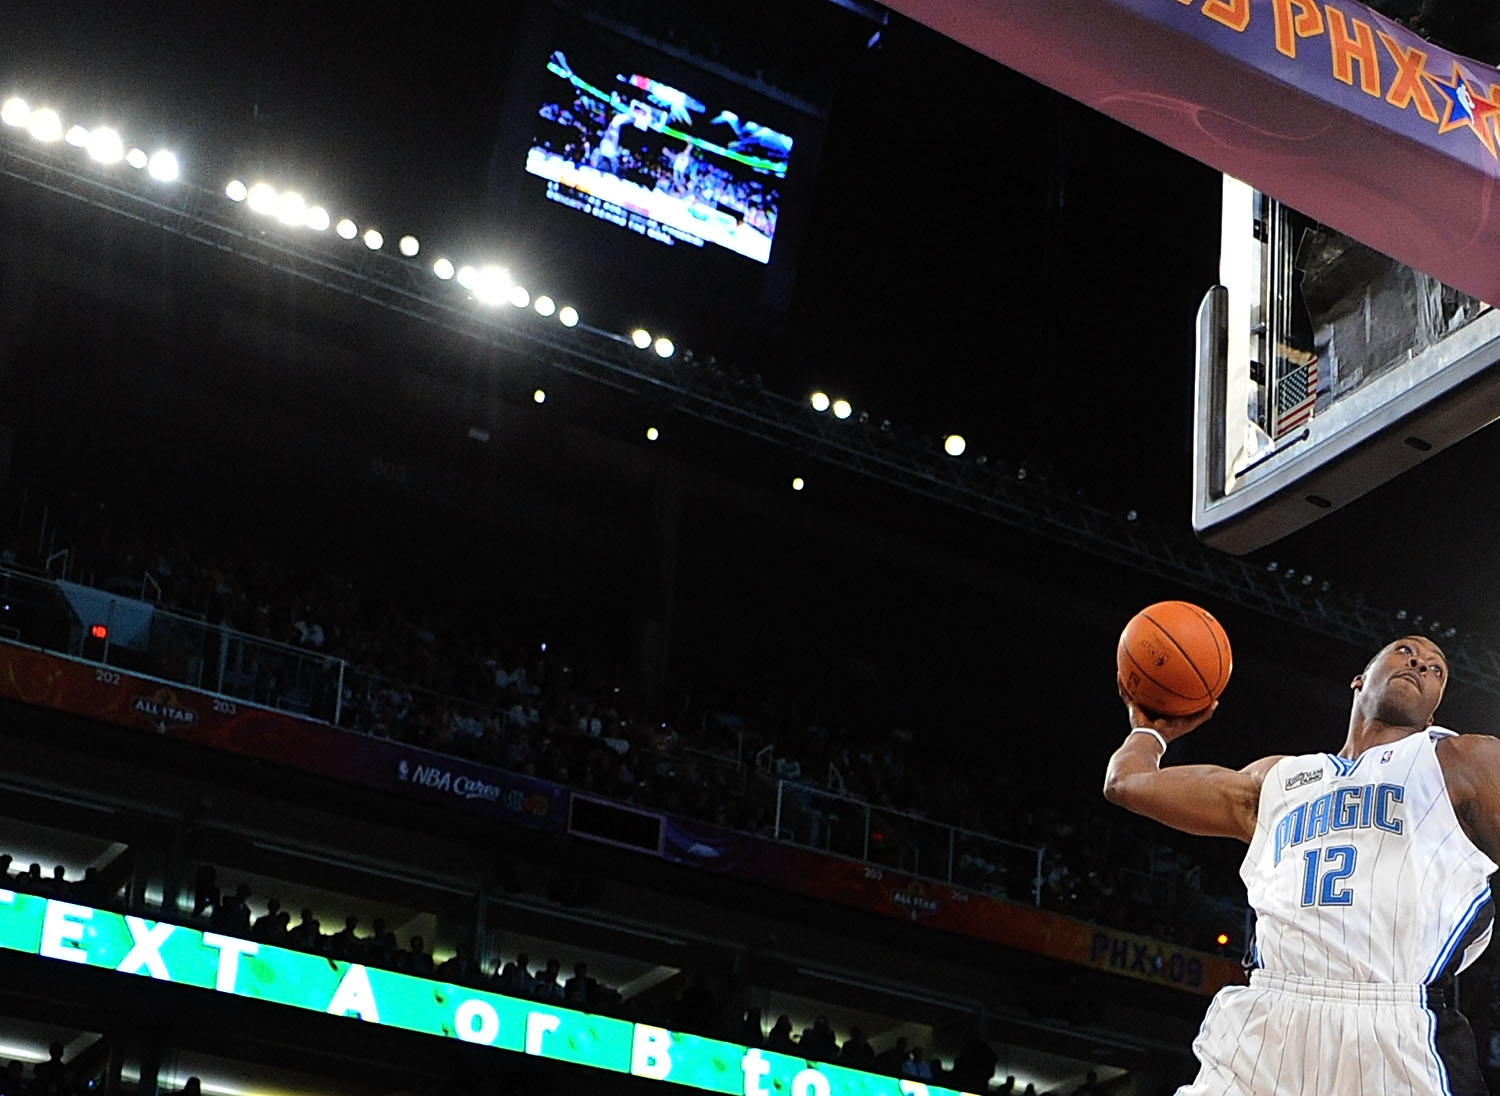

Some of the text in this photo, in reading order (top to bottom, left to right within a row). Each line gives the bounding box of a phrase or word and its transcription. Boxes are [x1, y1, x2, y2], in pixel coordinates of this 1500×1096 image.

[412, 763, 451, 793] NBA
[1274, 783, 1404, 868] MAGIC
[1301, 844, 1357, 907] 12
[1092, 933, 1148, 972] PHX
[0, 890, 258, 993] EXT
[326, 963, 379, 1023] A
[455, 999, 559, 1057] or
[631, 1022, 672, 1080] B
